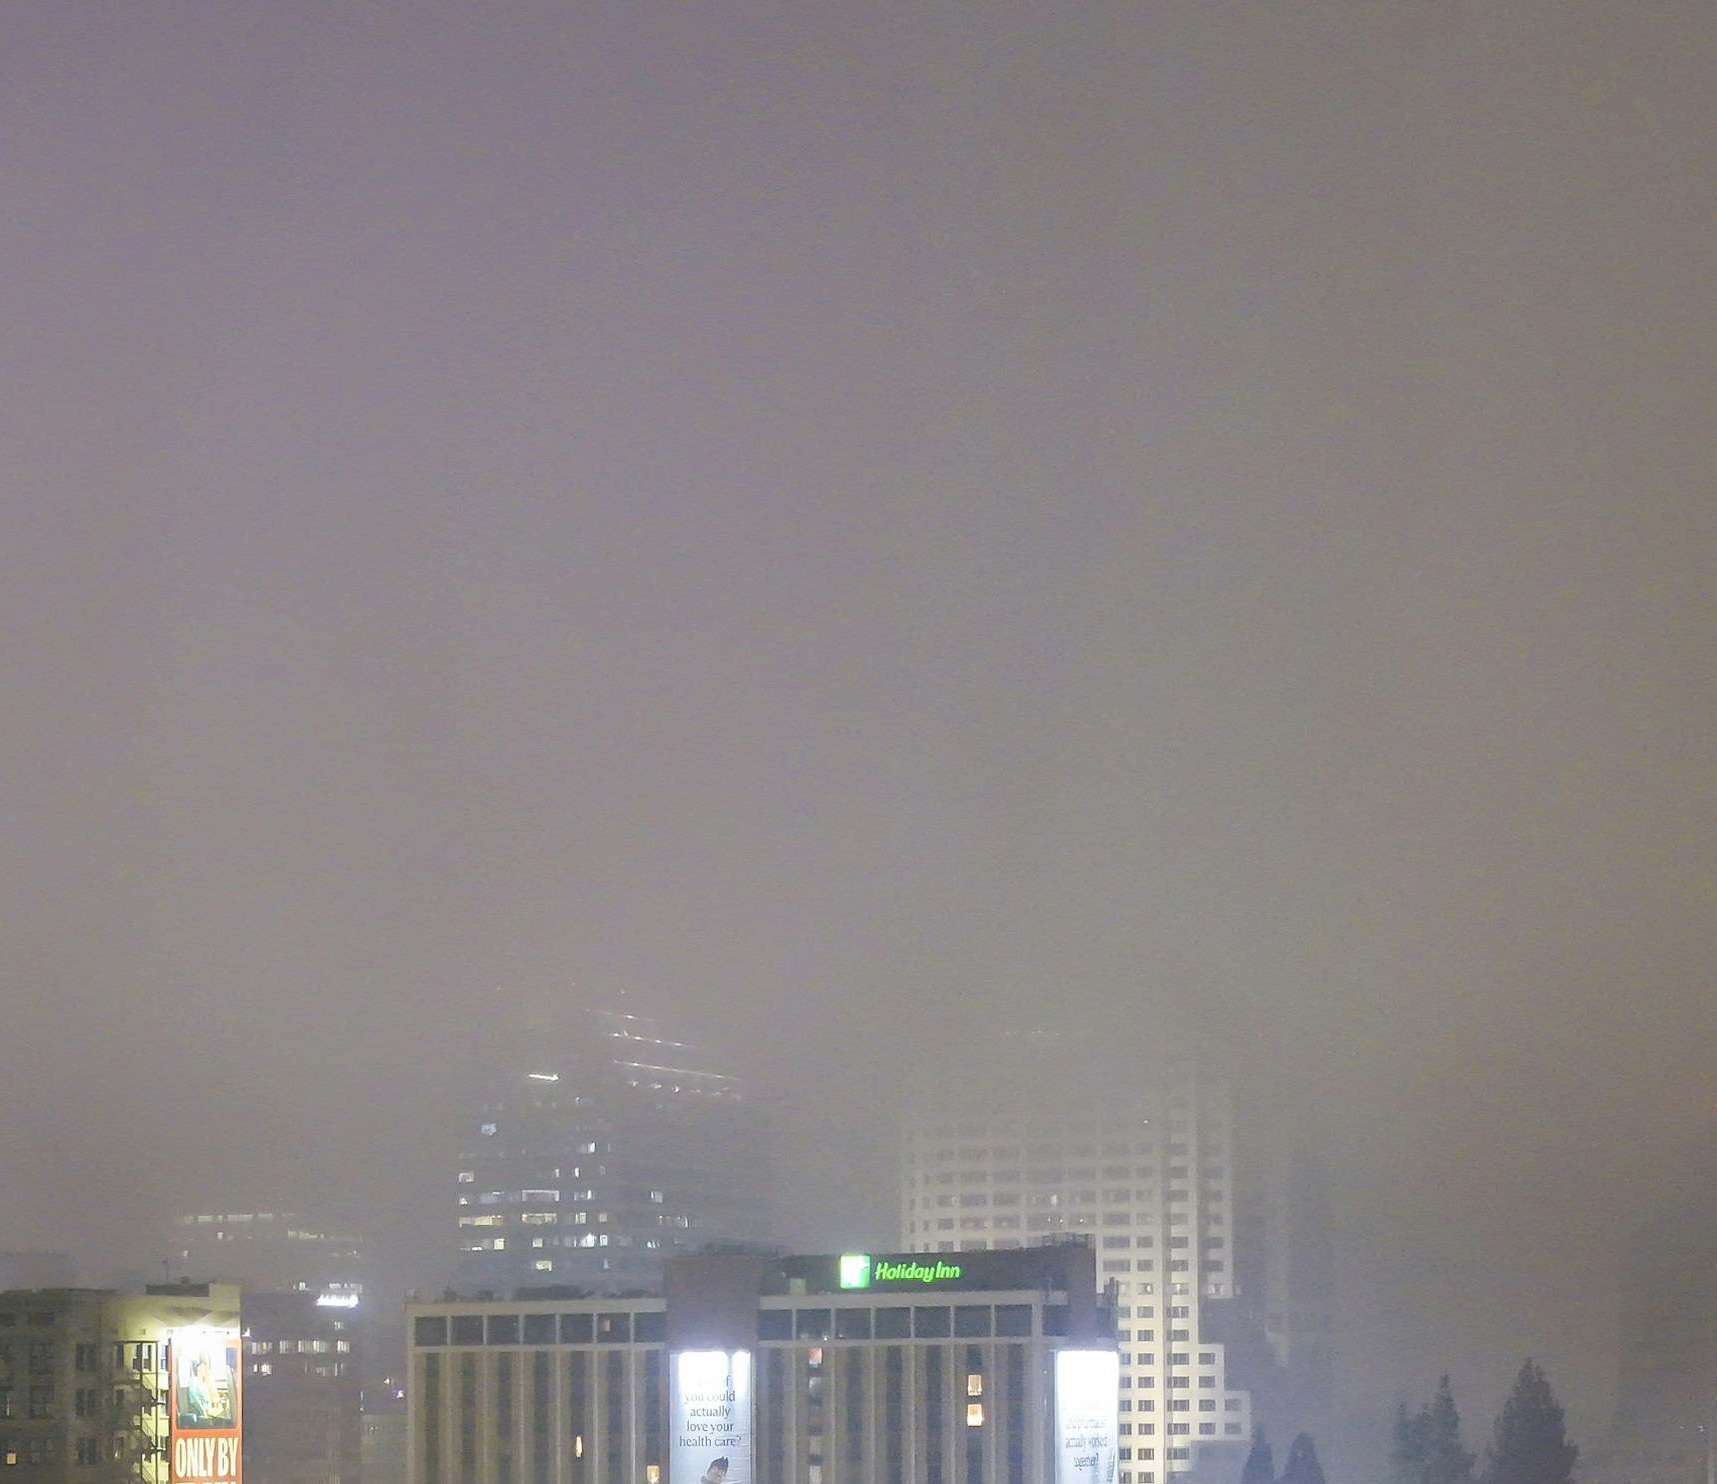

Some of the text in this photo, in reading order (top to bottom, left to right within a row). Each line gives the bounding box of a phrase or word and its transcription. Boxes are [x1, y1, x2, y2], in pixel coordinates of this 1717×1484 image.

[875, 1260, 960, 1283] Holiday Inn
[684, 1389, 736, 1405] you could
[690, 1405, 732, 1420] actually
[687, 1420, 735, 1434] love your
[679, 1435, 742, 1447] health care?
[175, 1436, 239, 1478] ONLY BY
